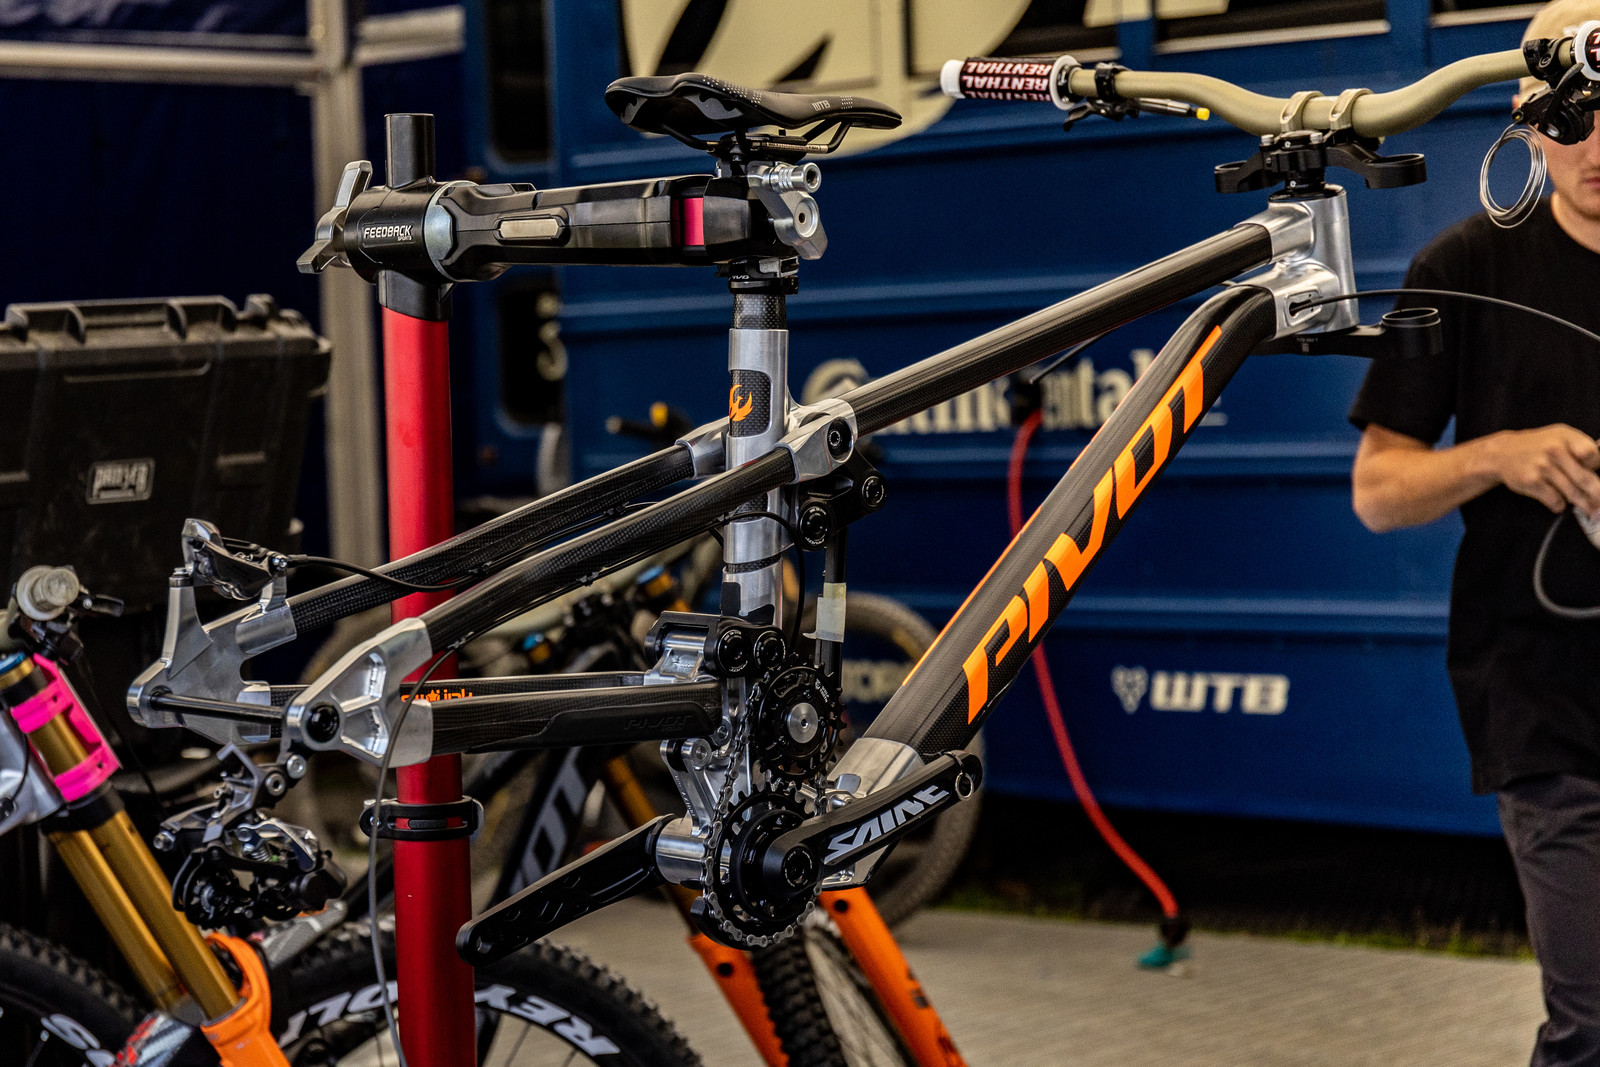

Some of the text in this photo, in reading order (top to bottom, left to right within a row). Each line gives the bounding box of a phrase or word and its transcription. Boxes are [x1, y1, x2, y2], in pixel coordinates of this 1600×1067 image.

[966, 61, 1054, 76] RENTHAL
[962, 75, 1049, 91] RENTHAL
[811, 99, 831, 112] WTB
[363, 225, 412, 239] FEEDBACK
[962, 324, 1222, 725] PIVOT
[1150, 671, 1291, 716] WTB
[823, 784, 950, 866] SAINT
